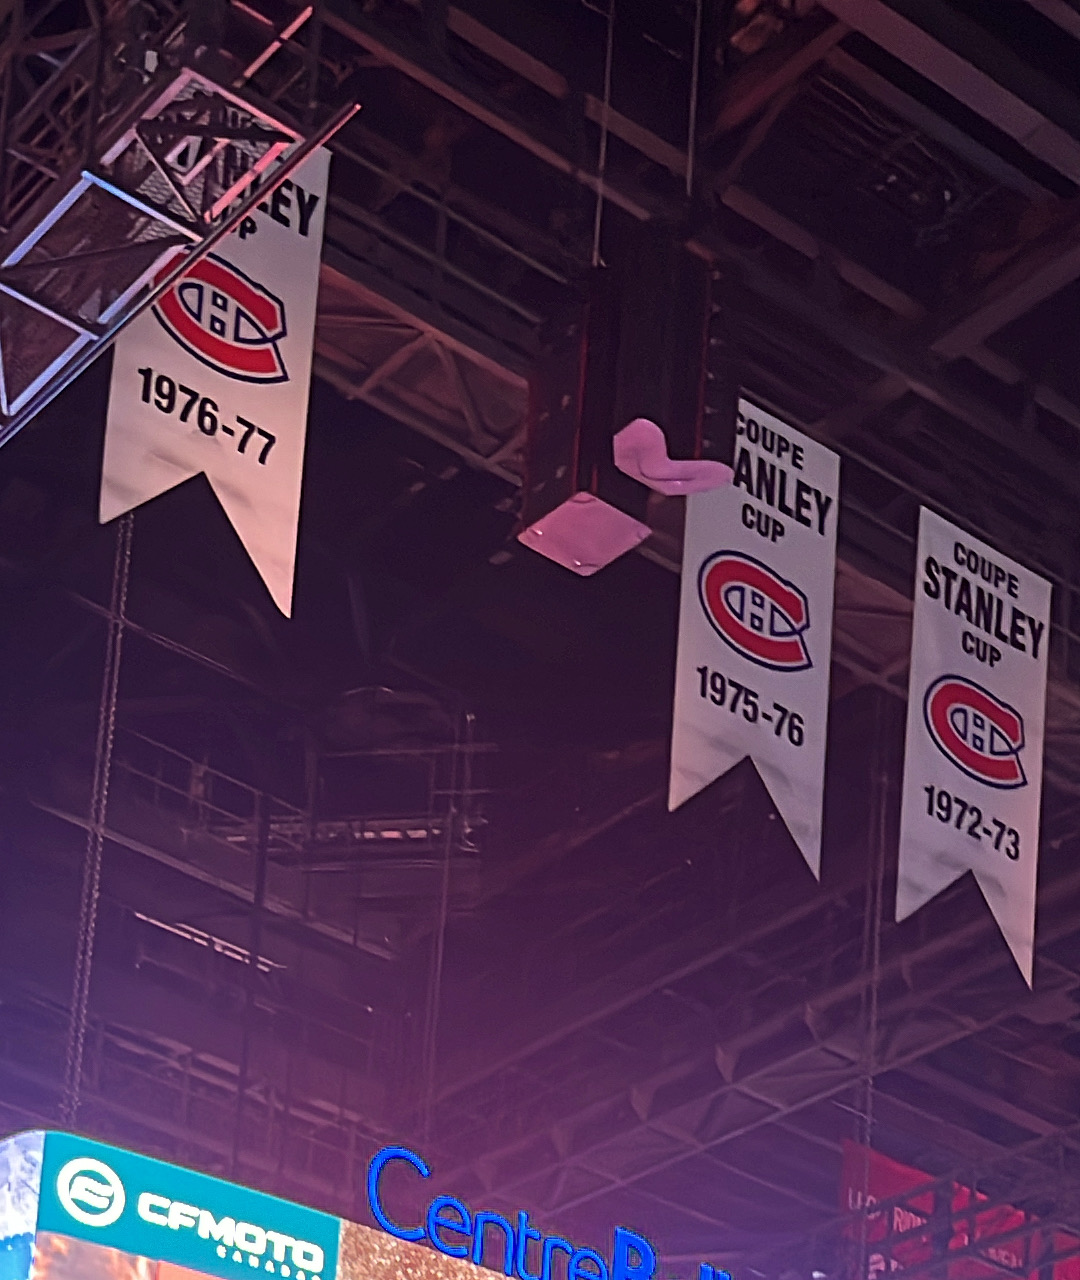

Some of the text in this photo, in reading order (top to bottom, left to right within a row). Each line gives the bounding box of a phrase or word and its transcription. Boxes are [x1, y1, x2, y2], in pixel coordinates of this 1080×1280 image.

[137, 367, 277, 466] 1976-77
[733, 447, 832, 536] ANLEY
[742, 504, 785, 544] CUP
[924, 557, 1045, 659] STANLEY
[954, 541, 1019, 598] COUPE
[961, 631, 1001, 668] CUP
[696, 665, 805, 747] 1975-76
[924, 784, 1020, 861] 1972-73
[137, 1191, 325, 1273] CFMOTO
